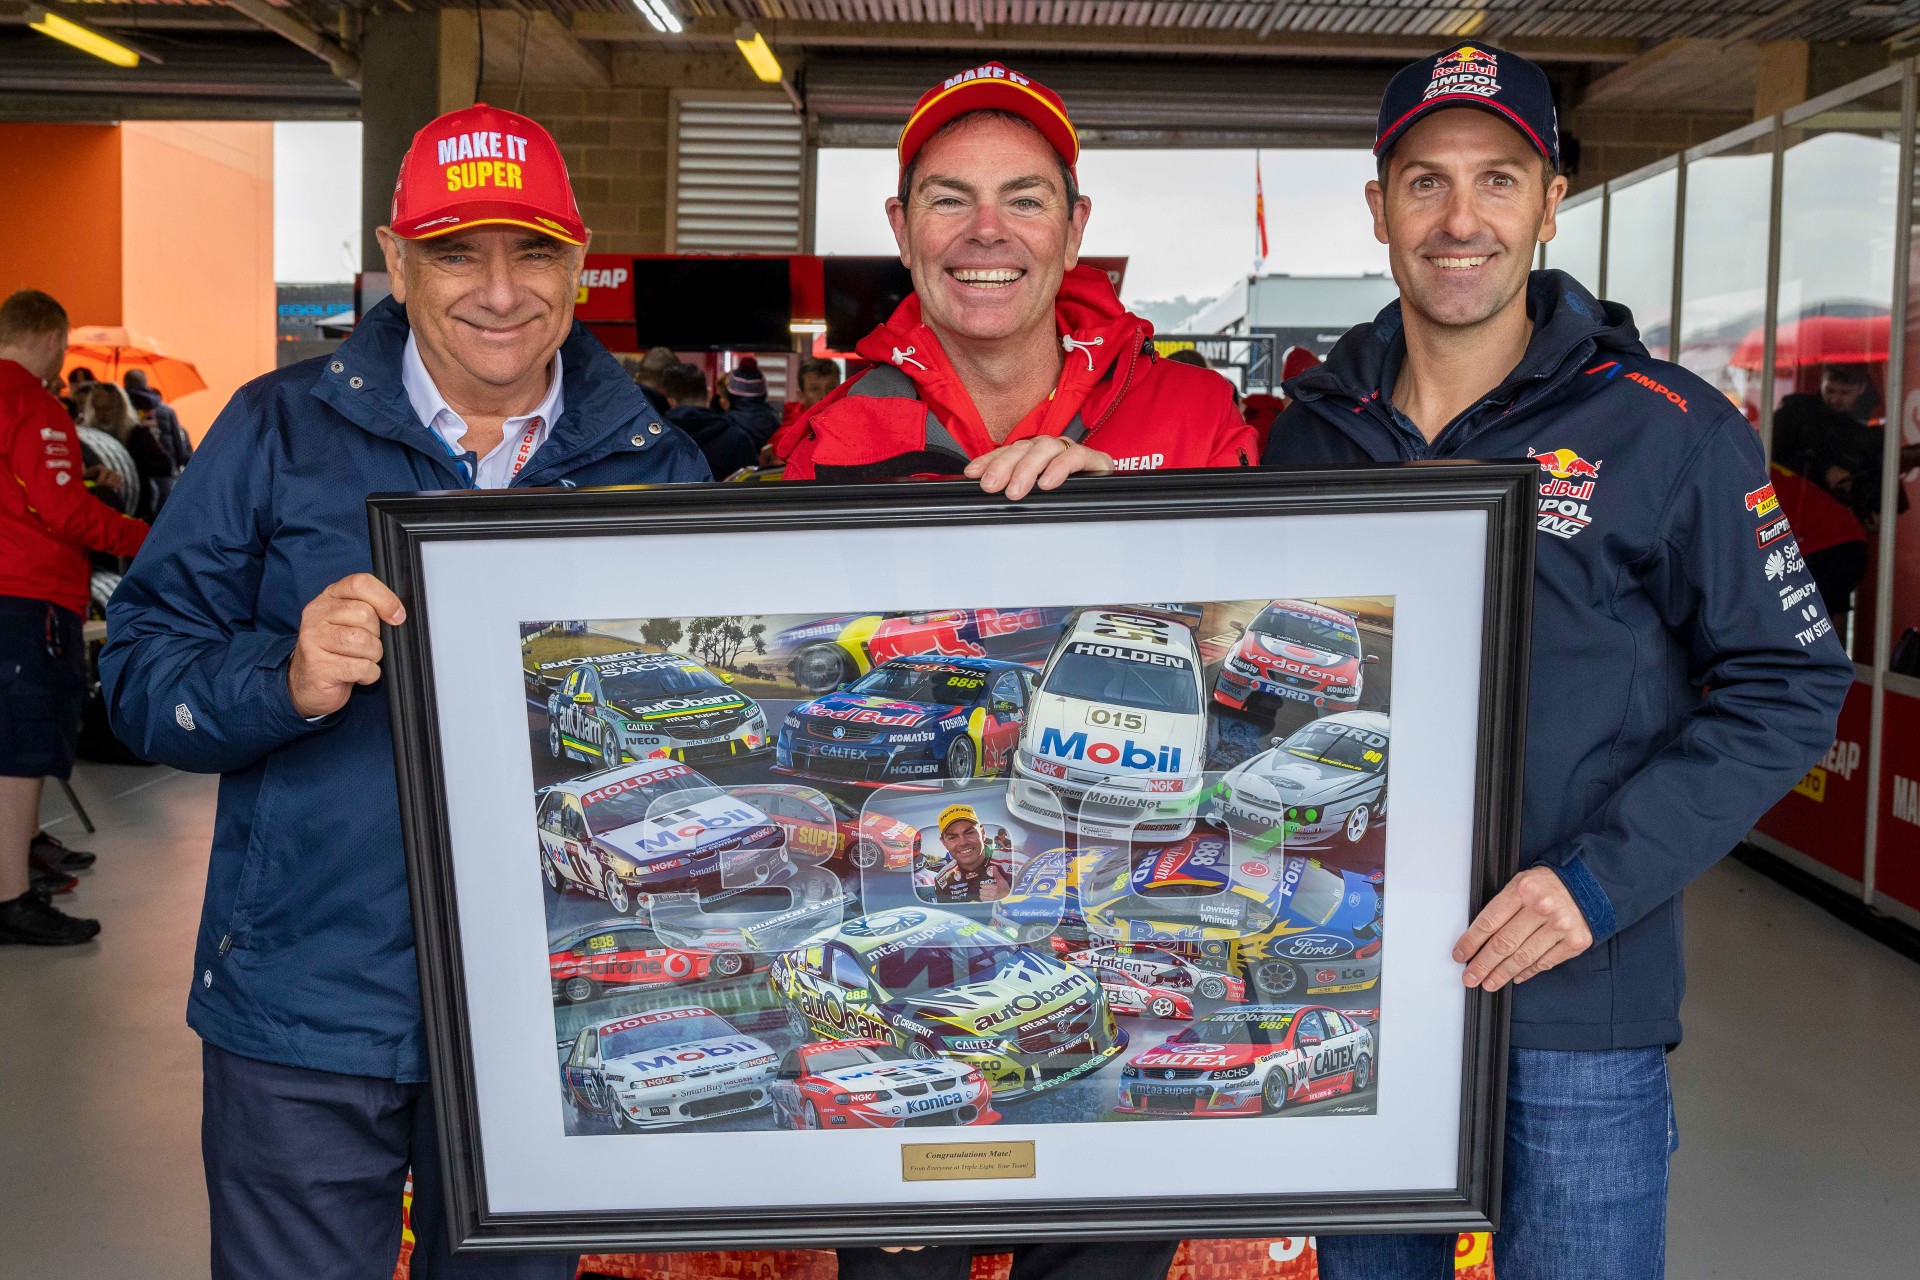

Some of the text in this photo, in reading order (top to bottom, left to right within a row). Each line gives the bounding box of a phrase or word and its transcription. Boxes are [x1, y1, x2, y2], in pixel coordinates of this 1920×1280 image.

[944, 66, 1029, 90] MAKE IT
[1432, 62, 1497, 80] Red Bull
[1424, 74, 1501, 93] AMPOL
[1423, 84, 1499, 101] RACING
[437, 131, 527, 165] MAKE IT
[446, 161, 522, 191] SUPER
[1624, 371, 1688, 412] AMPOL
[1554, 480, 1595, 500] Bull
[1539, 499, 1592, 522] POL
[1537, 514, 1584, 535] ING
[974, 608, 1041, 638] Red
[1272, 607, 1352, 633] FORD
[789, 623, 842, 641] TOSHIBA
[1795, 628, 1815, 647] TW
[1074, 644, 1184, 669] HOLDEN
[601, 660, 695, 677] SACHS
[1231, 658, 1259, 674] KOMATSU
[1244, 651, 1349, 684] vodafone
[947, 676, 977, 689] 888
[1219, 681, 1242, 697] NOKIA
[1326, 685, 1356, 695] KOMATSU
[1265, 685, 1310, 702] FORD
[665, 711, 720, 723] mtaa super
[801, 703, 925, 727] Red Bull
[939, 715, 969, 732] TOSHIBA
[1091, 709, 1143, 730] 015
[626, 723, 655, 731] CALTEX
[1307, 723, 1387, 748] FORD
[625, 737, 660, 745] IVECO
[686, 738, 704, 746] mtaa
[889, 730, 936, 743] KOMATSU
[820, 745, 868, 761] CALTEX
[1038, 726, 1182, 774] Mobil
[1362, 750, 1383, 763] 00
[890, 764, 939, 775] HOLDEN
[1033, 759, 1059, 776] NGK
[586, 766, 688, 804] HOLDEN
[1148, 780, 1174, 792] NGK
[1087, 791, 1162, 809] MobileNet
[1222, 802, 1283, 828] FALCON
[635, 808, 755, 853] Mobil
[750, 828, 769, 841] NGK
[798, 826, 847, 850] SUPER
[651, 861, 674, 872] NGK
[689, 860, 732, 878] SmartBuy
[1200, 903, 1240, 916] Lowndes
[1200, 913, 1239, 927] Whincup
[866, 922, 951, 962] mtaa super
[1118, 946, 1133, 955] 888
[1289, 937, 1339, 956] Ford
[551, 954, 662, 975] vodafone
[1091, 955, 1142, 973] Holden
[1341, 968, 1366, 979] LG
[605, 1008, 706, 1033] HOLDEN
[1019, 1004, 1076, 1032] mtaa super
[1258, 1021, 1284, 1030] 888
[901, 1018, 934, 1038] CRESCENT
[808, 1039, 886, 1054] HOLDEN
[955, 1039, 997, 1050] CALTEX
[1048, 1037, 1082, 1058] mtaa super
[631, 1041, 758, 1072] Mobil
[748, 1057, 768, 1067] NGK
[1135, 1053, 1239, 1066] CALTEX
[1314, 1044, 1355, 1075] CALTEX
[647, 1076, 671, 1087] NGK
[1213, 1067, 1249, 1080] SACHS
[680, 1084, 723, 1098] SmartBuy
[1136, 1084, 1194, 1097] mtaa super
[1224, 1079, 1260, 1089] CarsGuide
[851, 1094, 871, 1102] NGK
[906, 1092, 963, 1114] Konica
[925, 1151, 987, 1160] Congratulations
